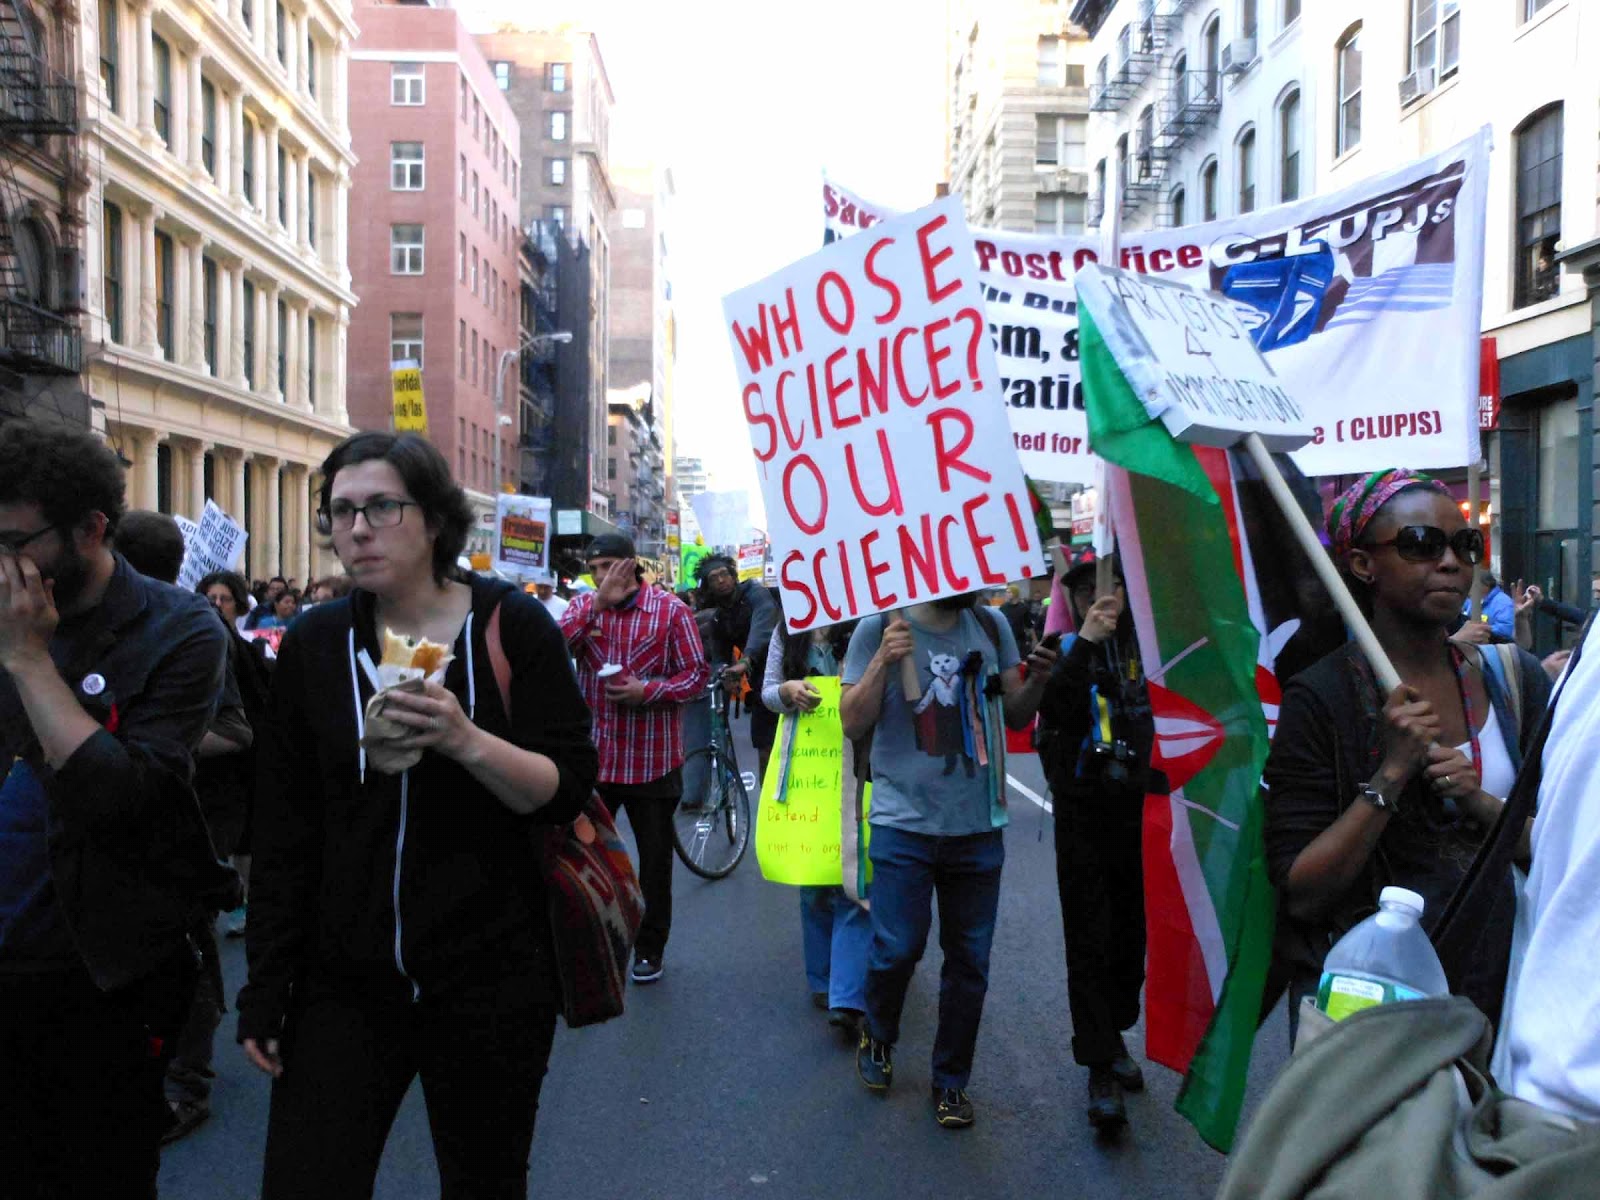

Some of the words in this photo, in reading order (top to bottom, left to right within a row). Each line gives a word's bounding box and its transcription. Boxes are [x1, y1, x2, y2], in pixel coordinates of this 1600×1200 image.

[823, 184, 884, 230] Sav
[732, 214, 963, 375] WHOSE
[975, 239, 1066, 281] Post
[742, 307, 984, 462] SCIENCE?
[782, 407, 993, 536] OUR
[1052, 433, 1082, 455] for
[220, 521, 240, 541] JUST
[781, 492, 1032, 630] SCIENCE!
